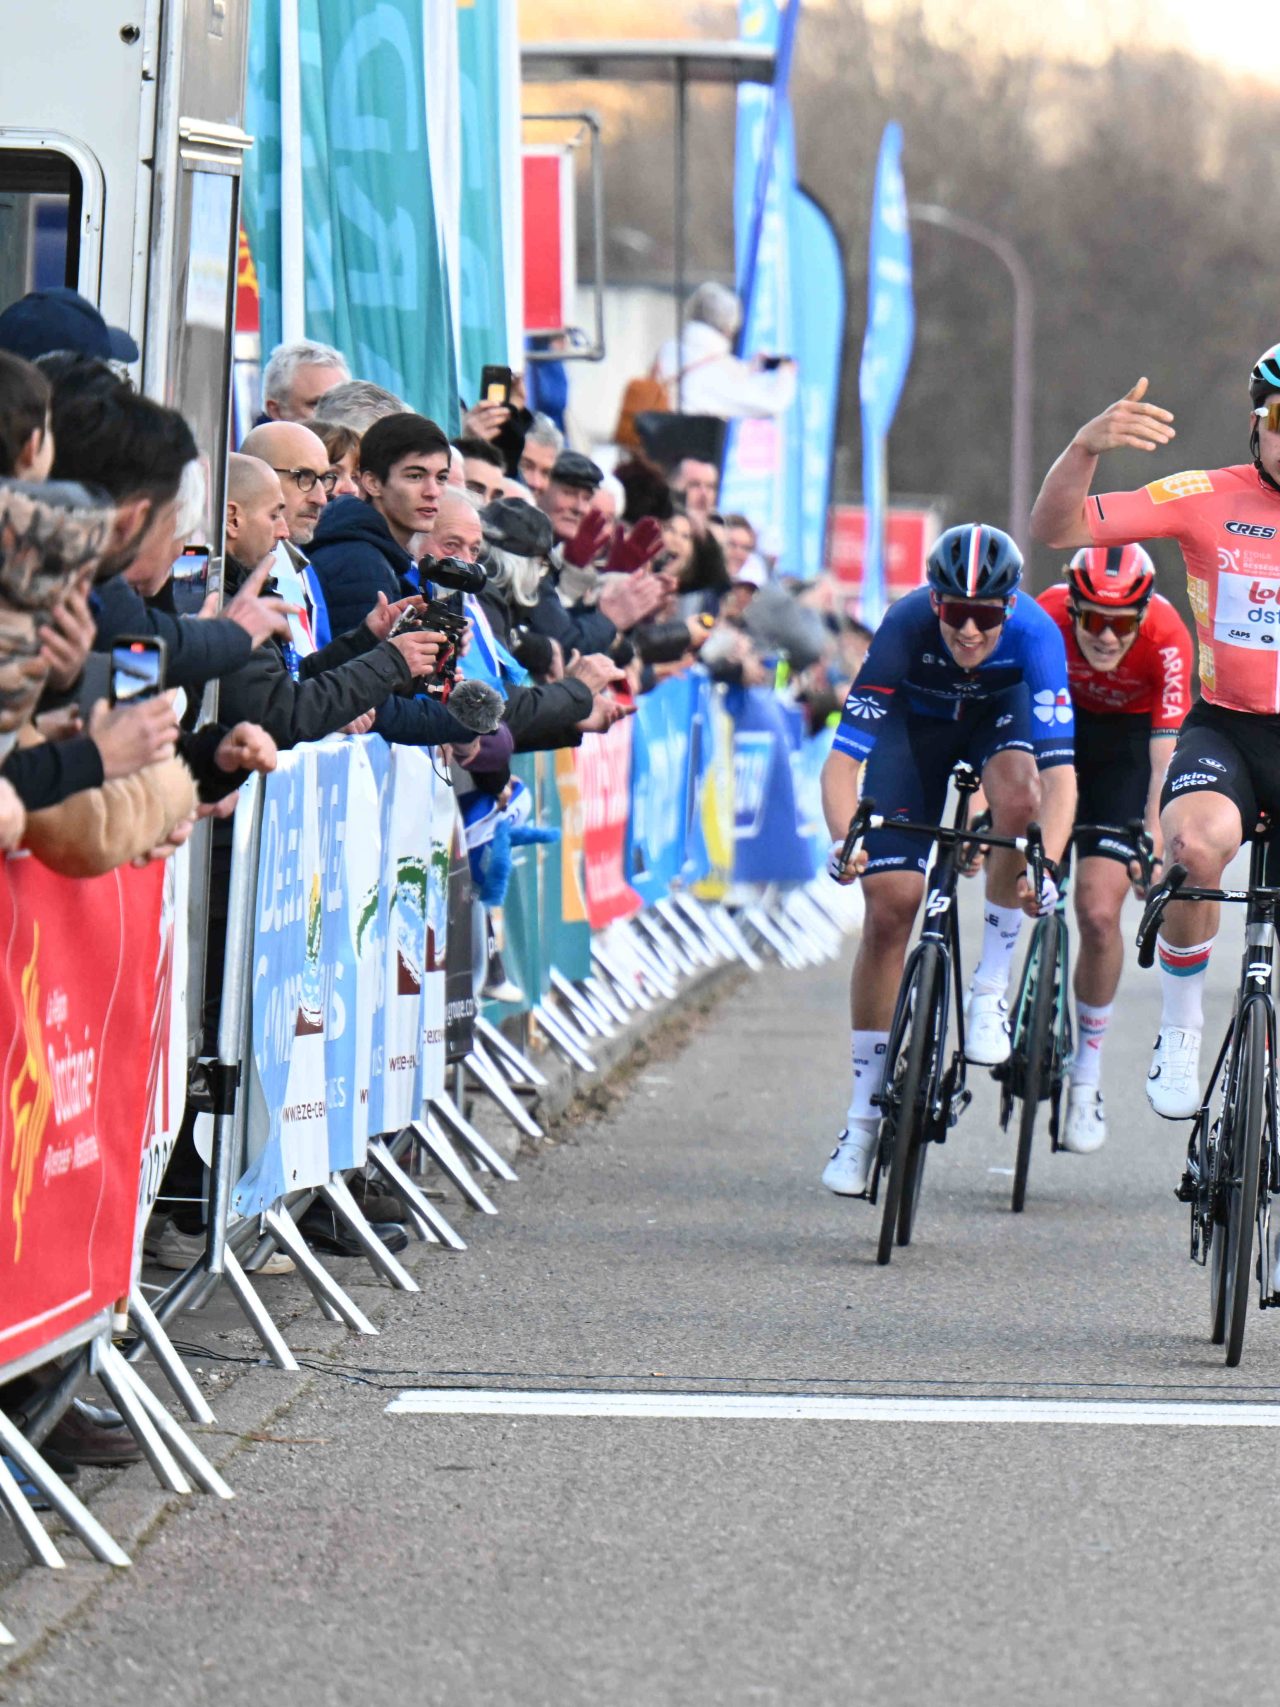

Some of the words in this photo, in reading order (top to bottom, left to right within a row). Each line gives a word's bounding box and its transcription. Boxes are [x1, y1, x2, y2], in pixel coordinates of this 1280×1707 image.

[1225, 521, 1276, 538] CRES
[1159, 646, 1184, 719] ARKEA
[1171, 771, 1218, 786] viking
[1171, 779, 1209, 792] lotto
